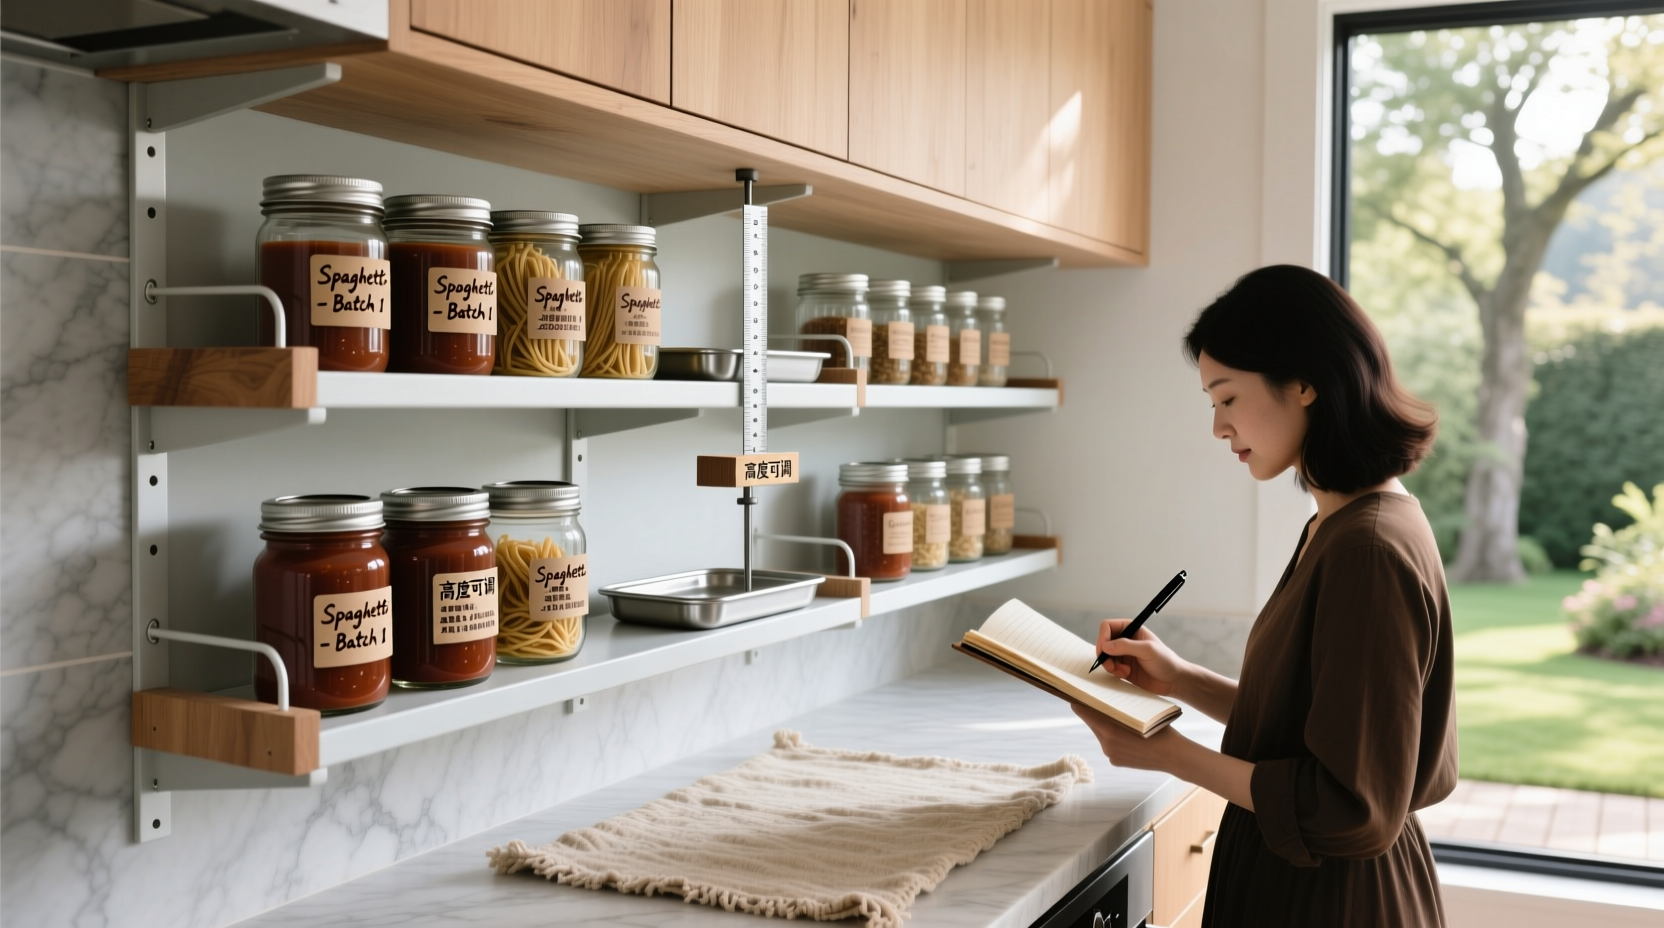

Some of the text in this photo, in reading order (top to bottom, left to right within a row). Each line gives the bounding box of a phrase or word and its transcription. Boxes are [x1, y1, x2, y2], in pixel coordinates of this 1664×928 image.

[333, 294, 374, 313] Batch
[447, 302, 485, 321] Batch
[744, 459, 792, 480] 高度可调
[335, 628, 377, 652] Batch
